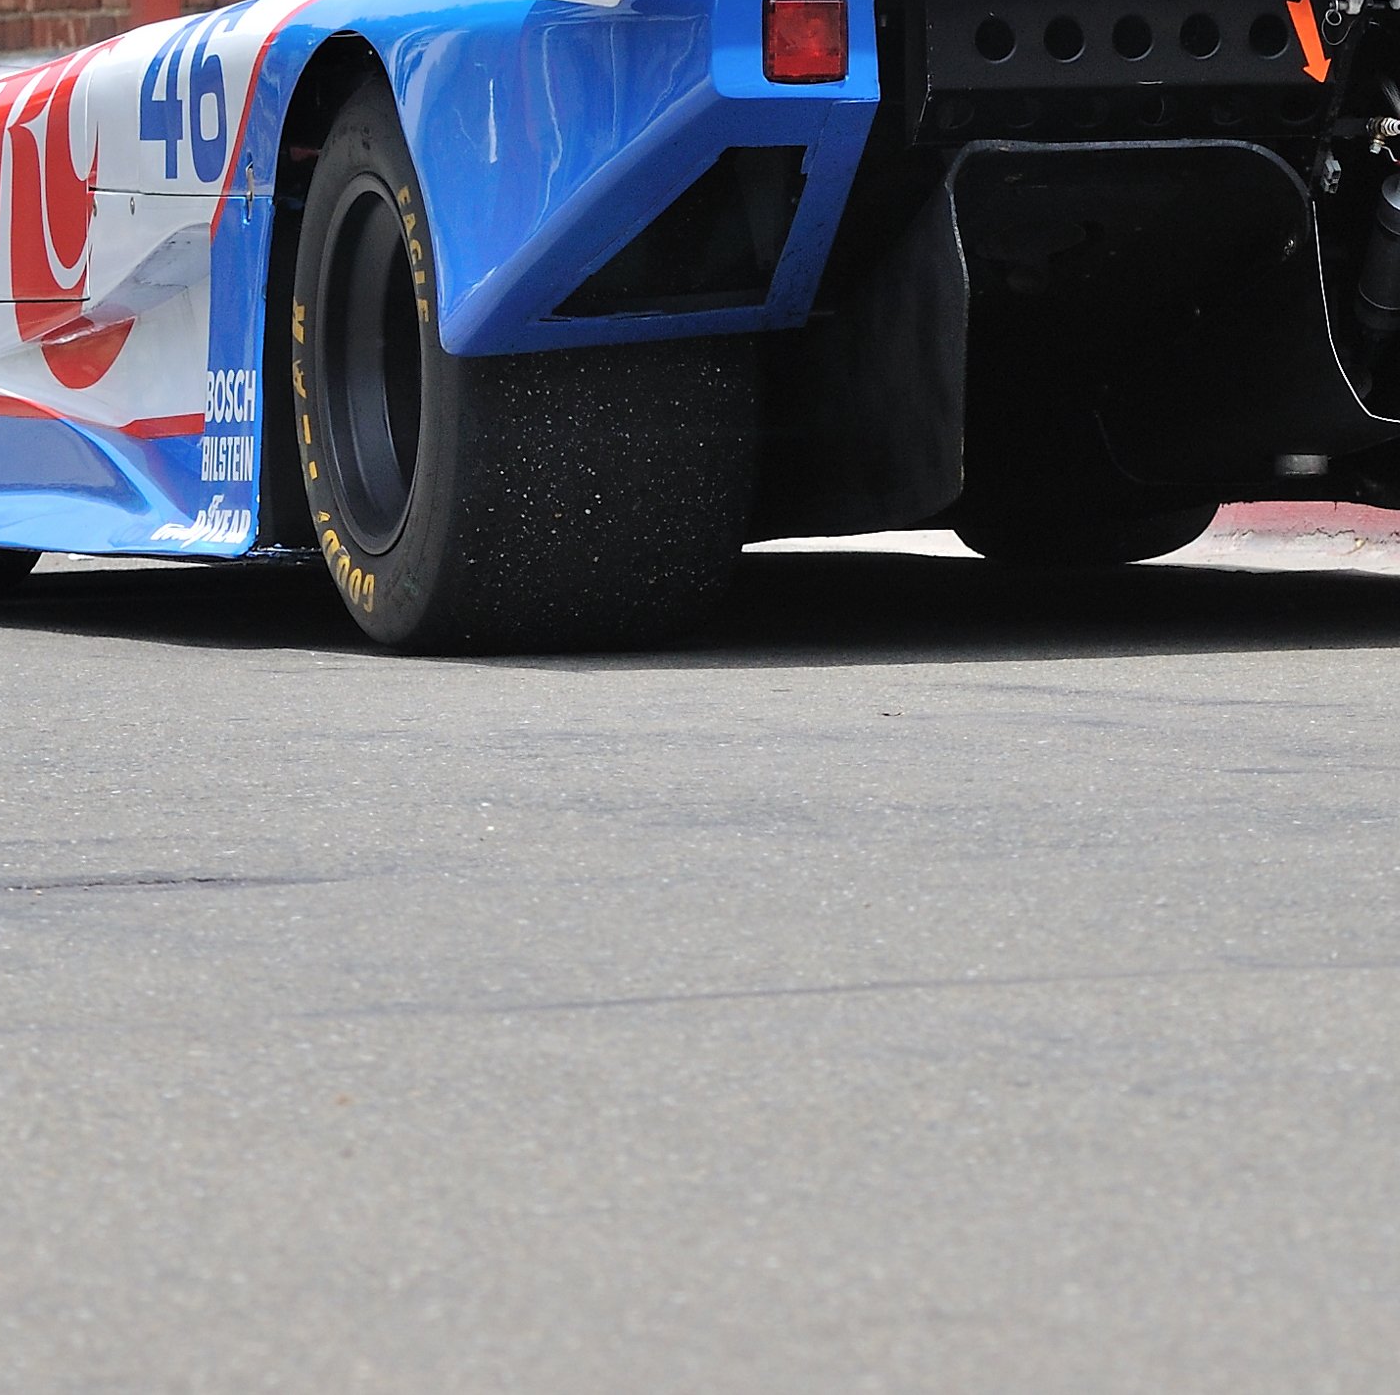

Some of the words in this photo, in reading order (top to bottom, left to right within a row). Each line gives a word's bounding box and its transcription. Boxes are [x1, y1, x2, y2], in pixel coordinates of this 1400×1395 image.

[397, 184, 431, 324] EAGLE
[205, 369, 257, 424] BOSCH
[201, 435, 255, 483] BILSTEIN
